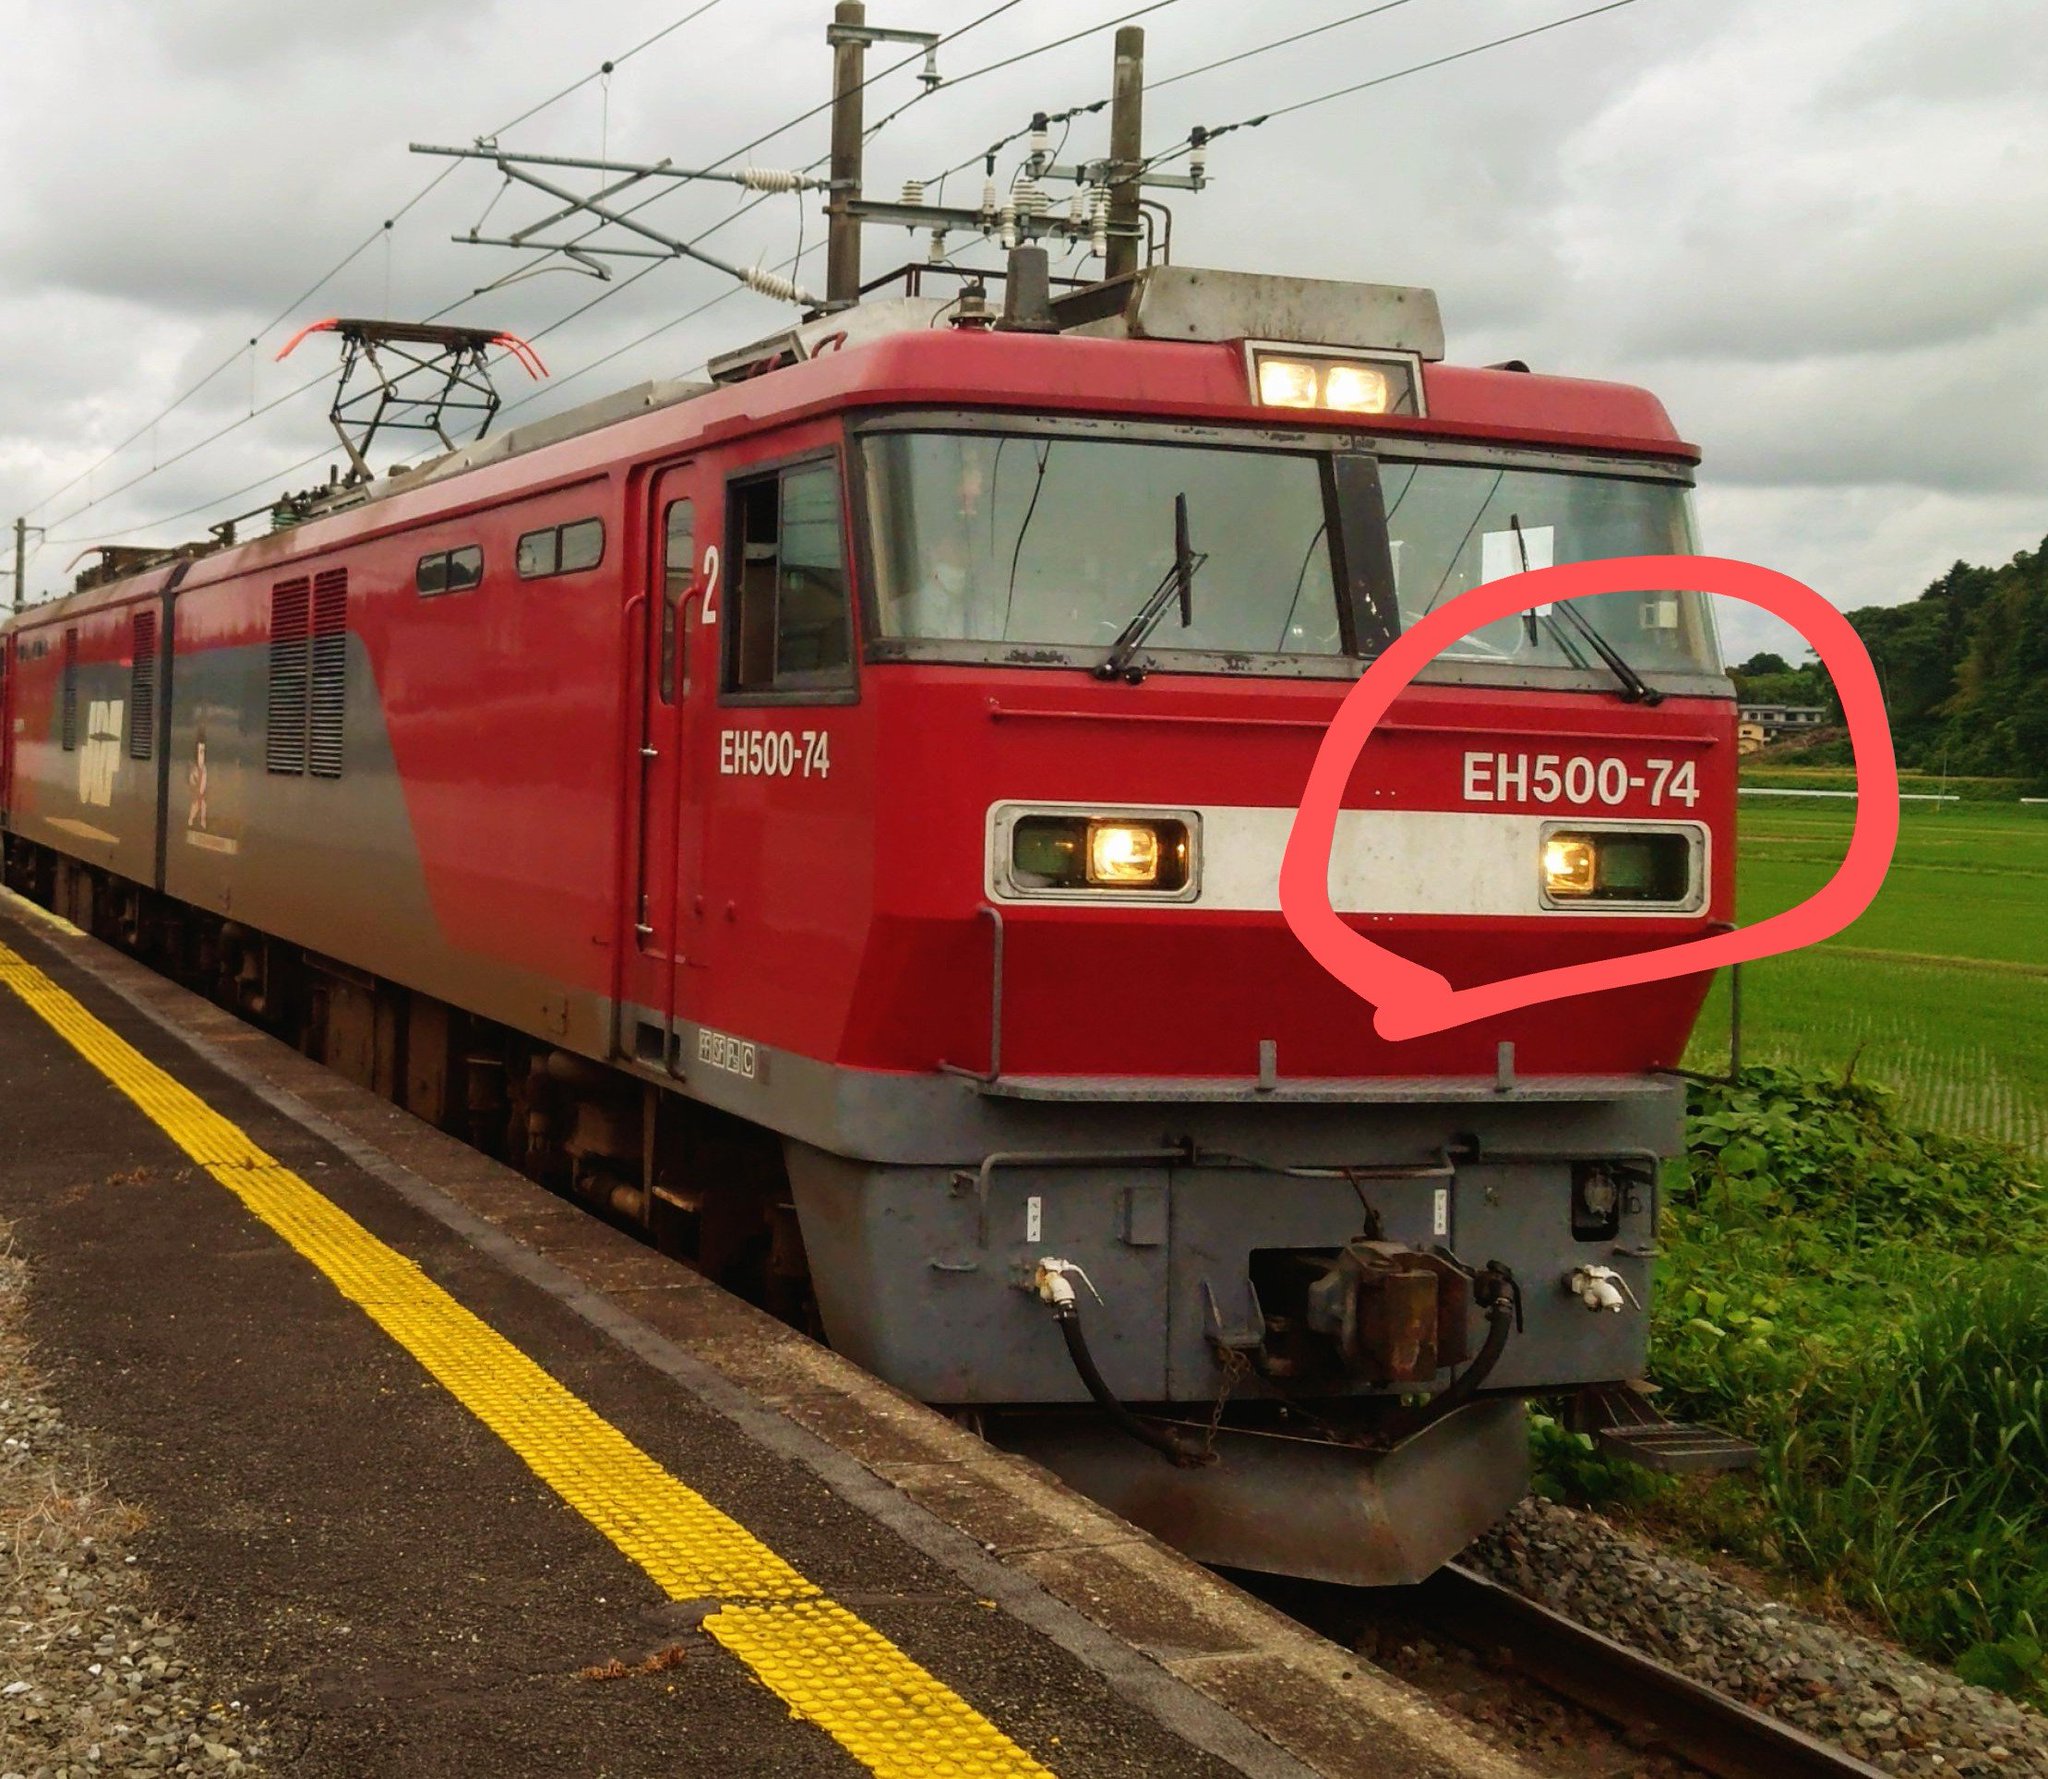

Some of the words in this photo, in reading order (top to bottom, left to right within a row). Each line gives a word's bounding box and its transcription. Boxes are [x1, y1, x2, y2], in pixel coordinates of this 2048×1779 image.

[702, 545, 719, 623] 2
[720, 730, 830, 778] EH500-74
[1464, 752, 1700, 807] EH500-74
